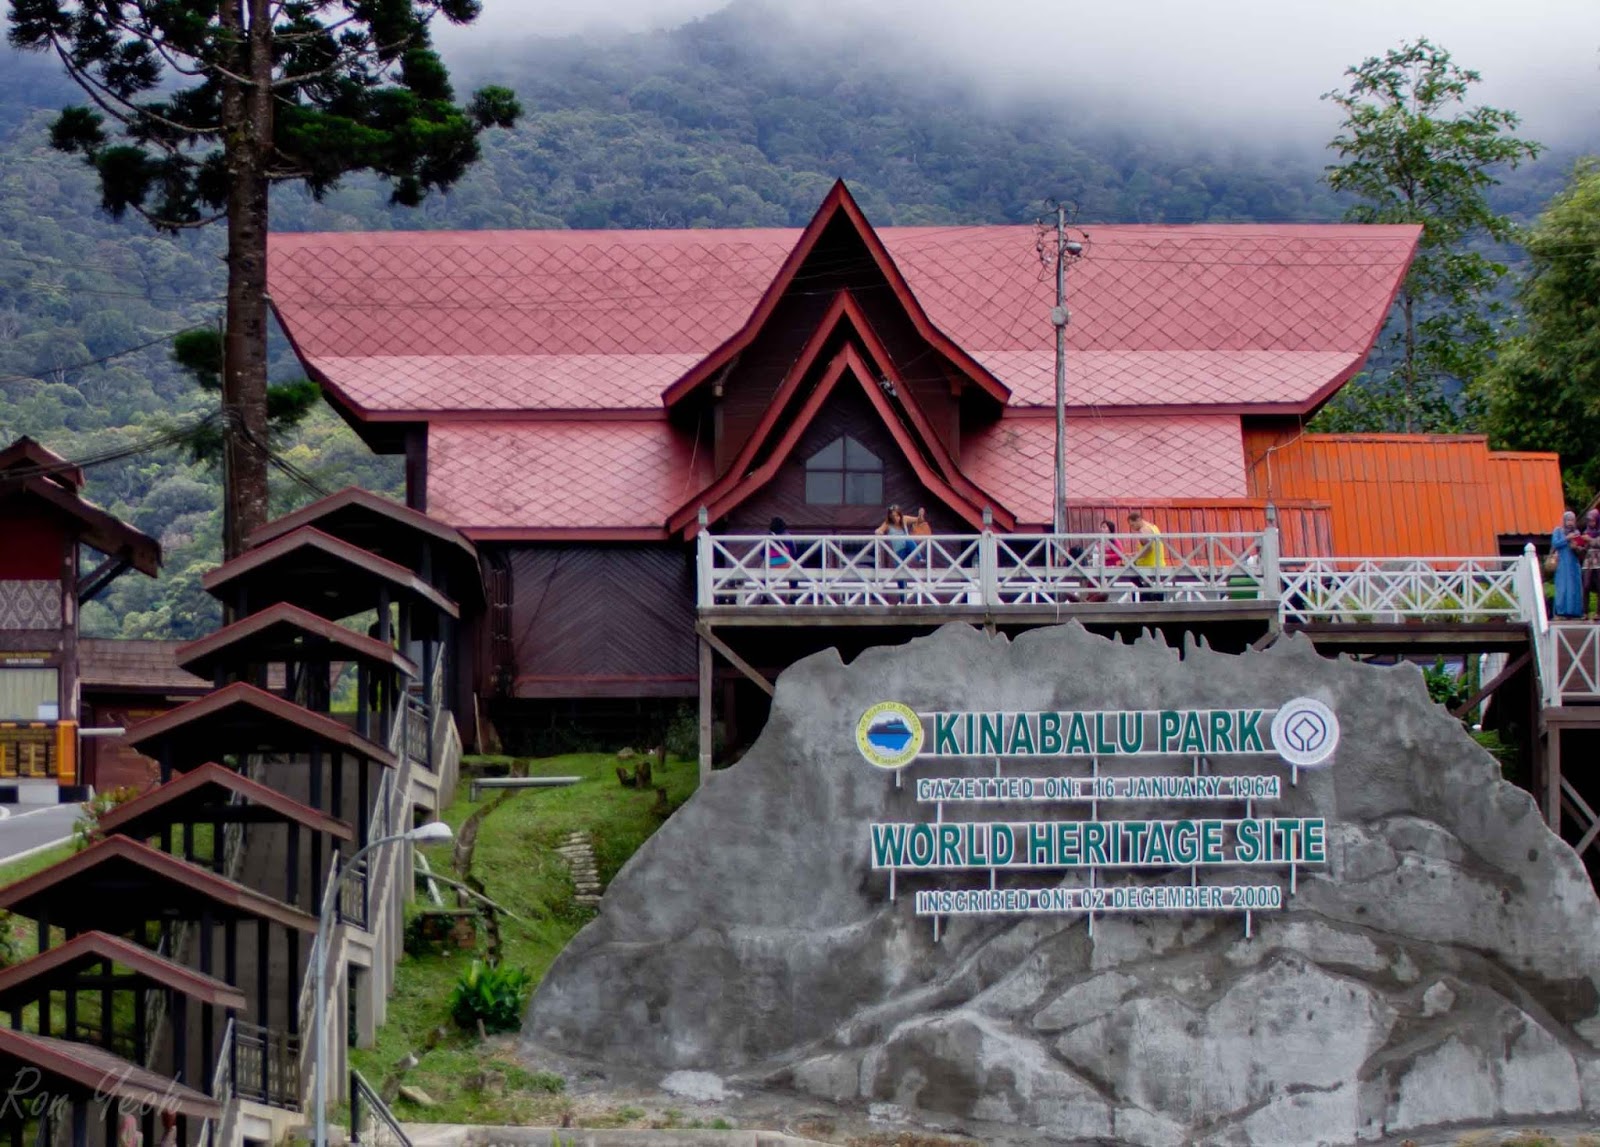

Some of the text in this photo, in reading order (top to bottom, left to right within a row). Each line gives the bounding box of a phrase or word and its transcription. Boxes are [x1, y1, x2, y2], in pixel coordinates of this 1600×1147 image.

[935, 709, 1266, 755] KINABALU PARK
[918, 774, 1280, 800] GAZETTED ON: 16 JANUARY 1964
[870, 817, 1326, 867] WORLD HERITAGE SITE
[917, 885, 1281, 913] INSCRIBED ON: 02 DECEMBER 2000
